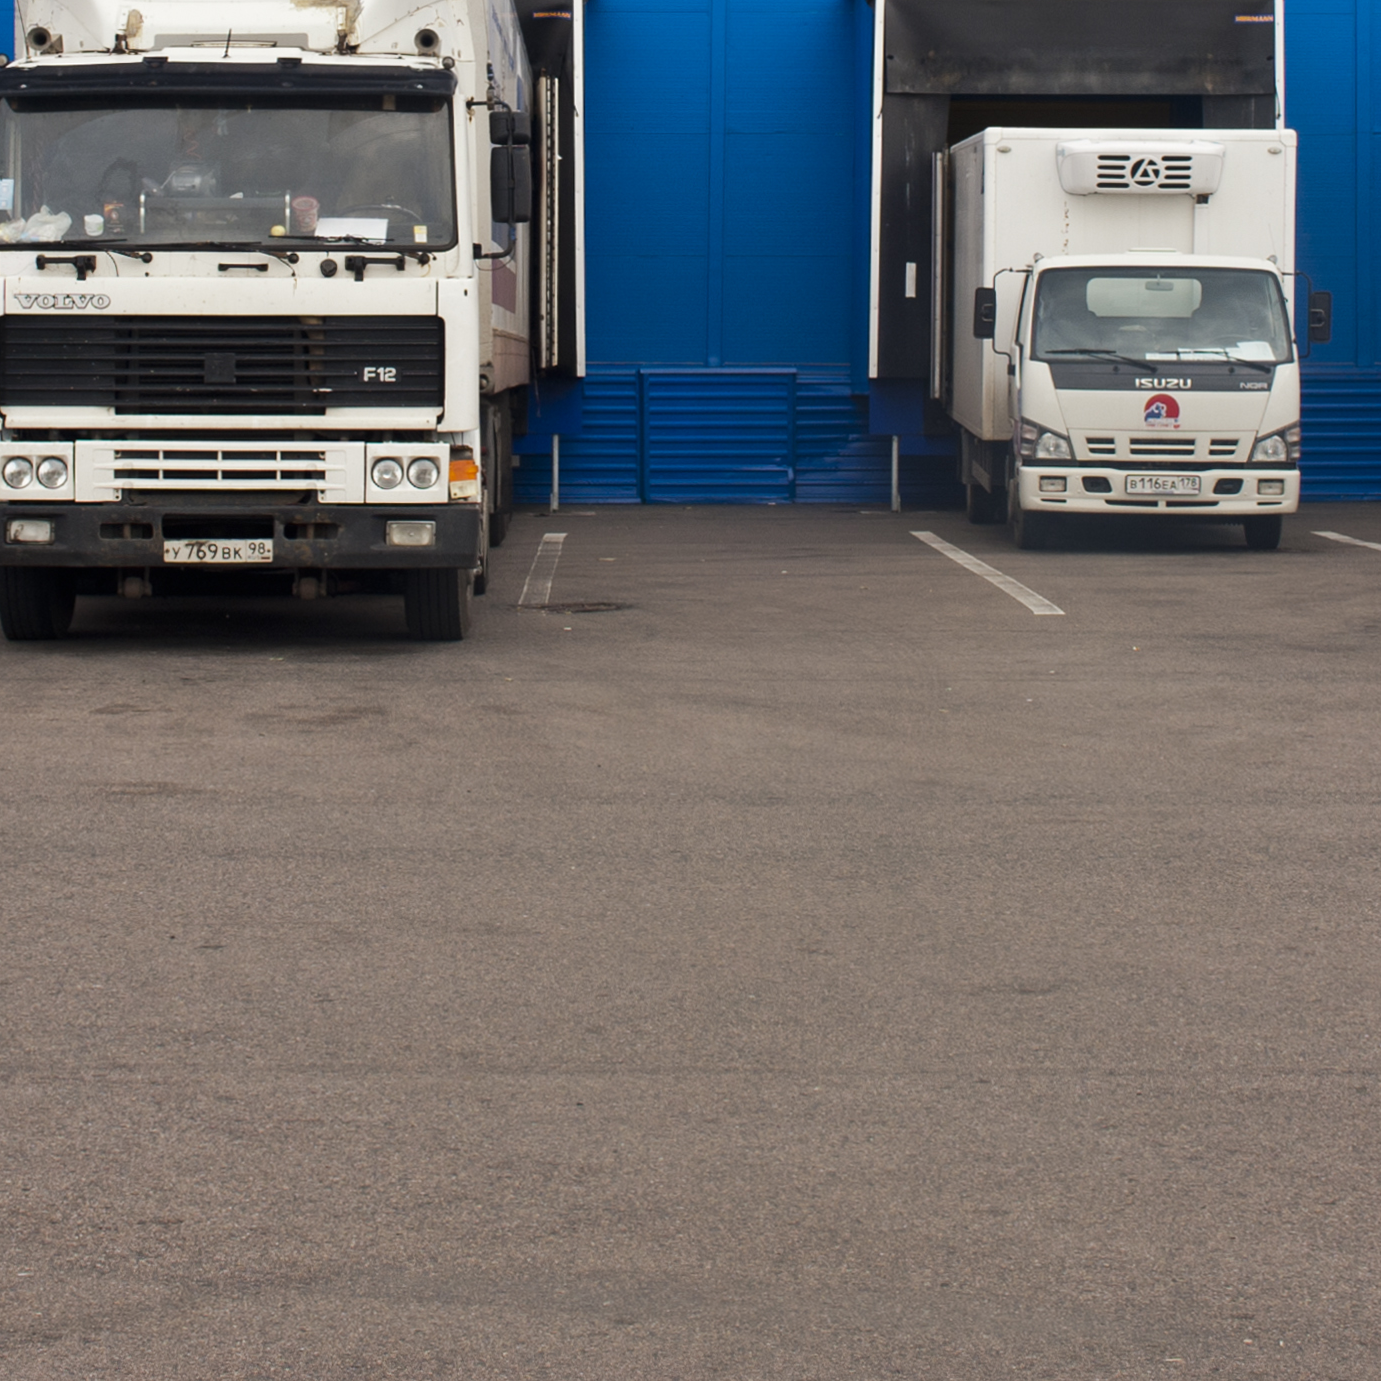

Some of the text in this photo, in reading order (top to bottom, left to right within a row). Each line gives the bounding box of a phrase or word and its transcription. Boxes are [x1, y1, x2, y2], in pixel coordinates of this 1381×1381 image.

[13, 293, 111, 310] VOLVO
[363, 367, 396, 383] F12
[1135, 378, 1192, 389] ISUZU
